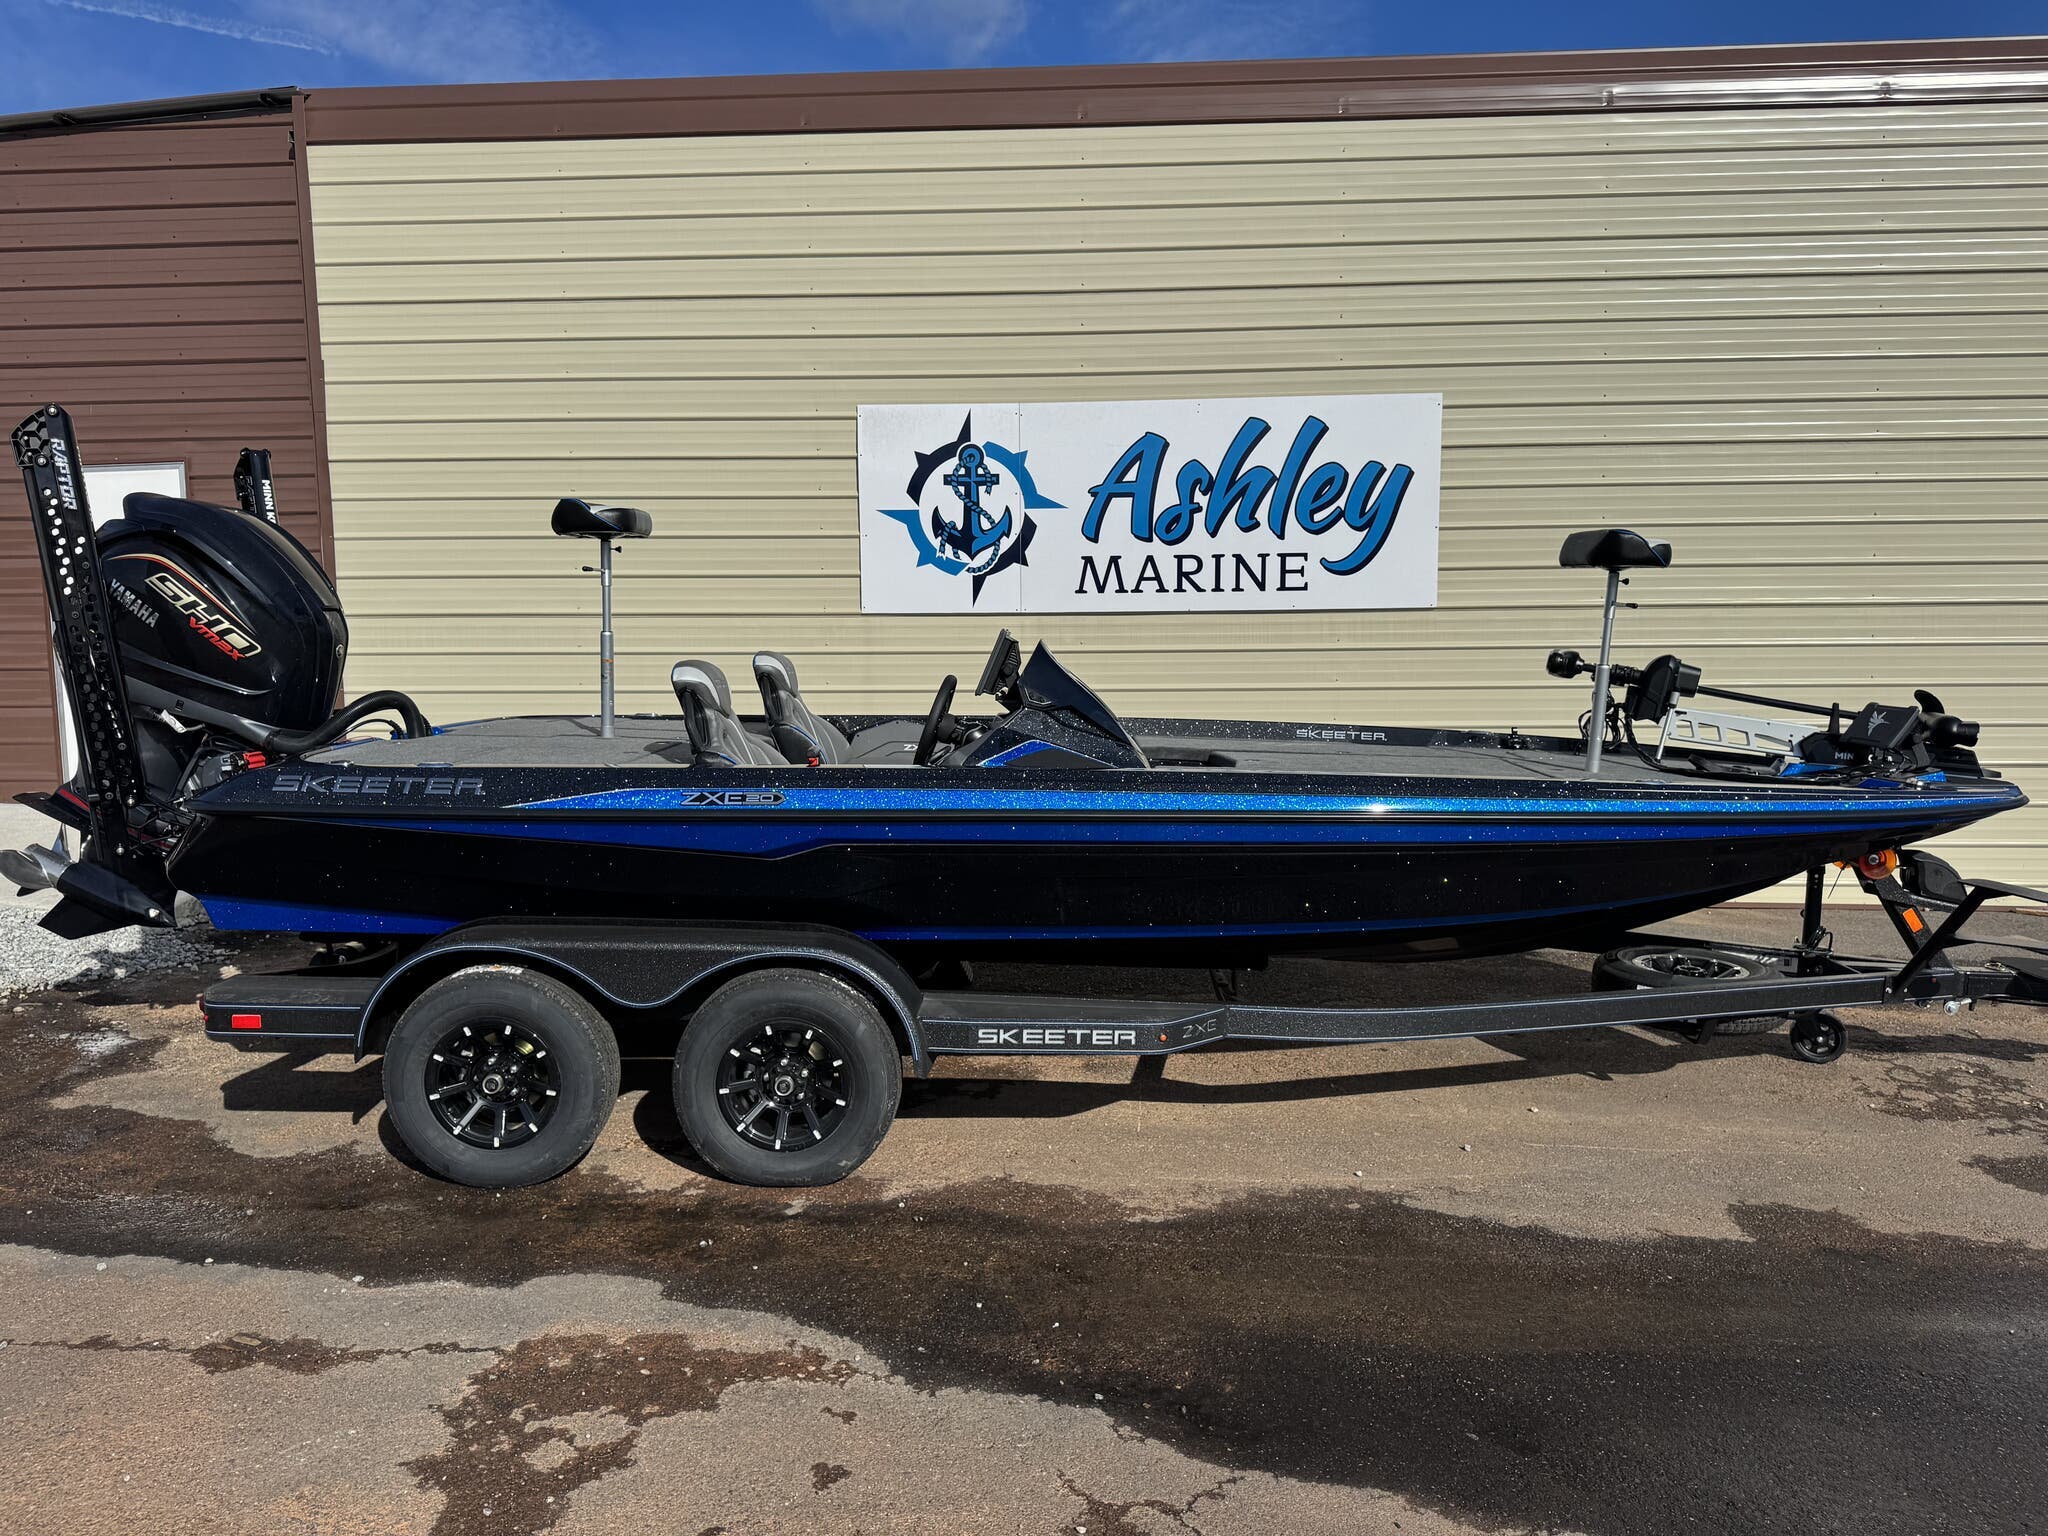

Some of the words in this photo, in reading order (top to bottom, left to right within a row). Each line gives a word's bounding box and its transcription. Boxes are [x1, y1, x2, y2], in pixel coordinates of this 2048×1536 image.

[50, 438, 78, 510] RAPTOR
[261, 479, 275, 510] MINN
[1081, 415, 1414, 576] Ashley
[1075, 552, 1309, 593] MARINE
[108, 578, 160, 628] YAMAHA
[144, 573, 262, 658] SHO
[1296, 729, 1386, 741] SKEETER
[272, 774, 485, 796] SKEETER
[978, 1028, 1137, 1045] SKEETER
[1182, 1018, 1218, 1040] ZXE
